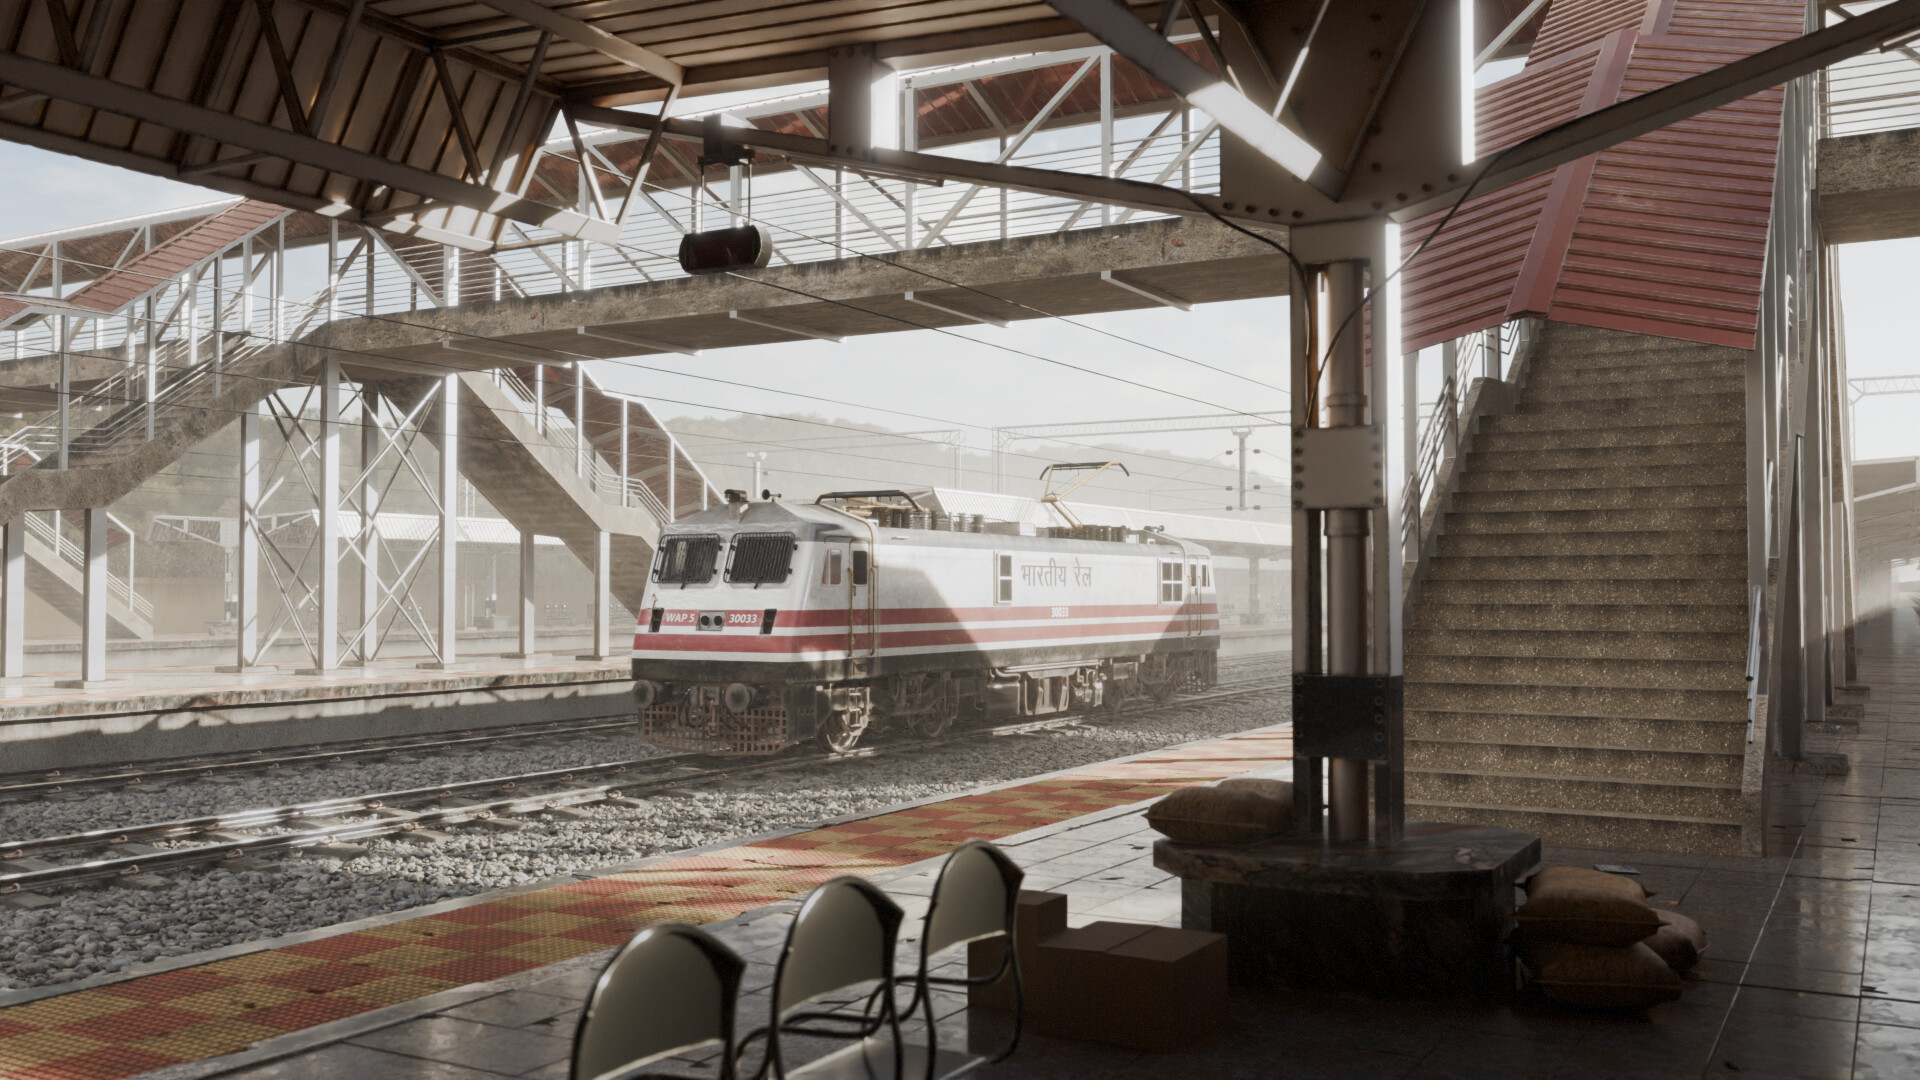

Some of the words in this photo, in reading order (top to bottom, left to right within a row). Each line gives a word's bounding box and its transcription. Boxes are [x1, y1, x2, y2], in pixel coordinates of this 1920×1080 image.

[1021, 557, 1067, 587] भारतीय
[1074, 557, 1092, 587] रेल
[666, 613, 688, 623] WAP
[688, 613, 695, 623] 5
[728, 613, 758, 624] 30033
